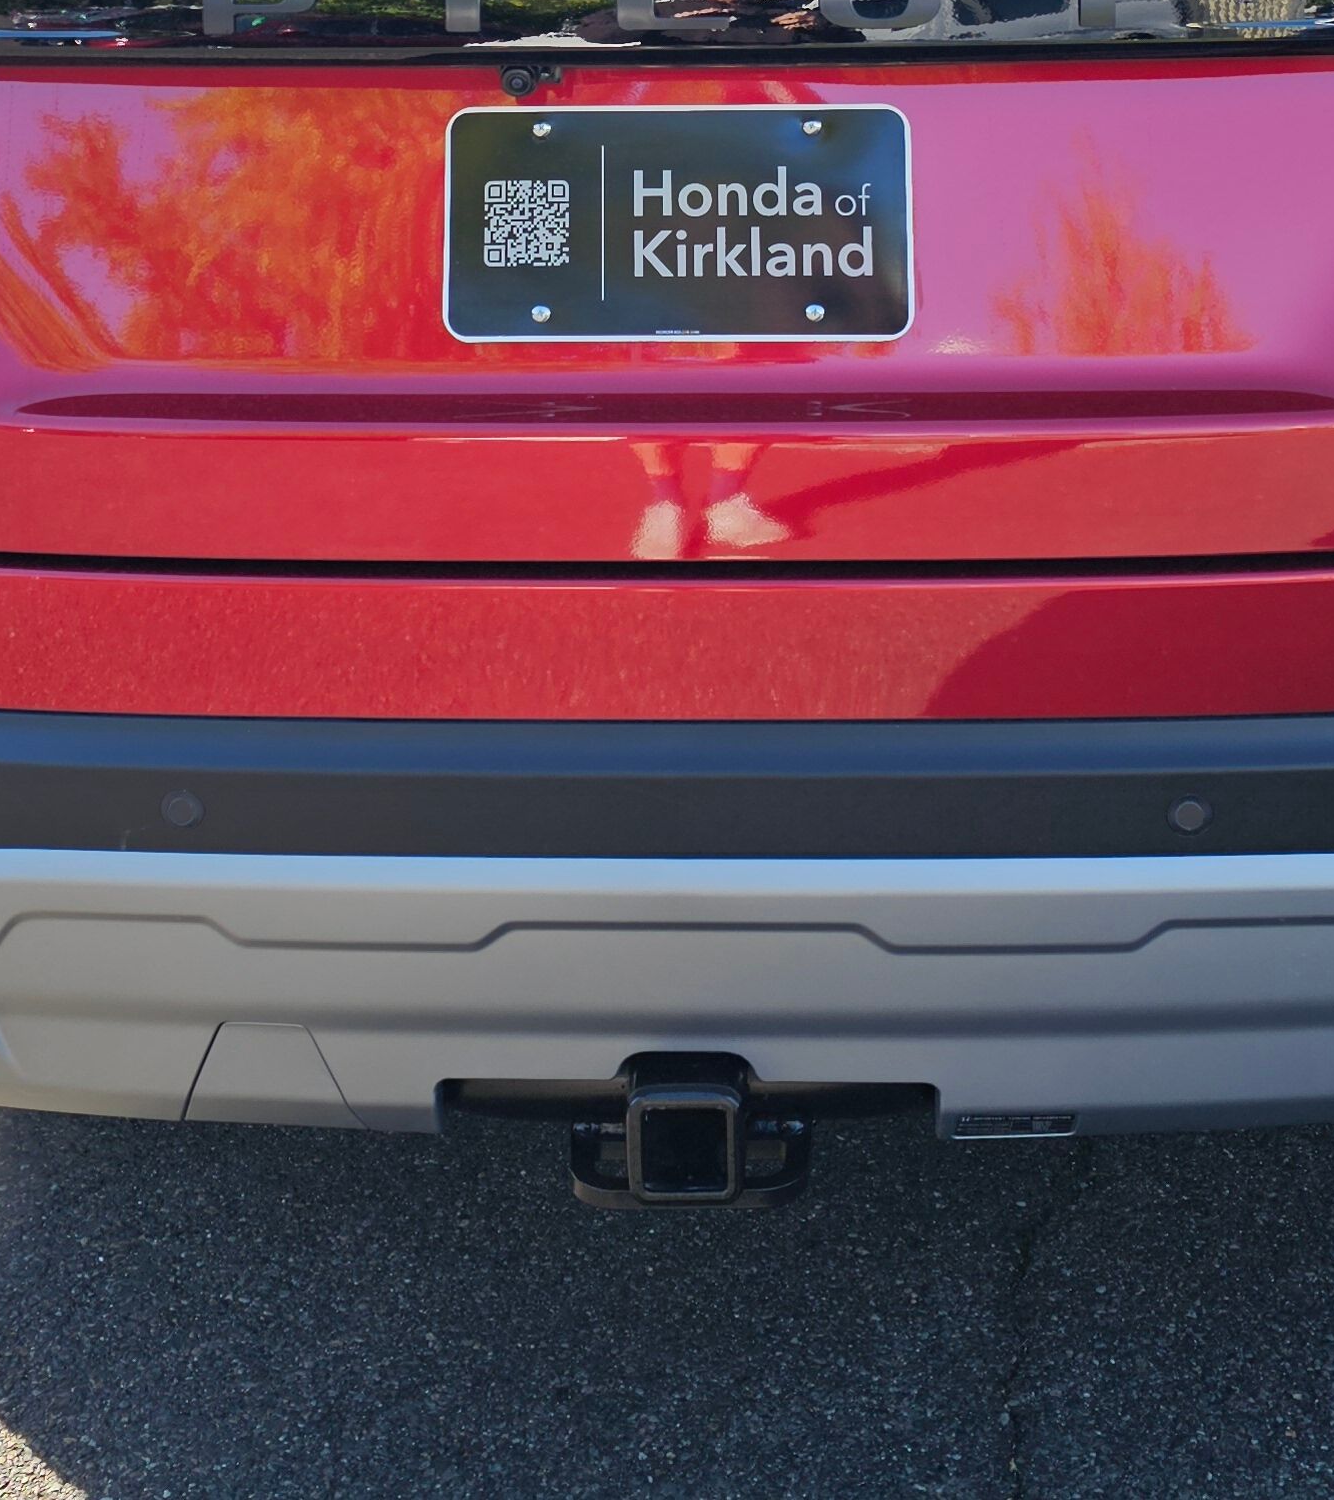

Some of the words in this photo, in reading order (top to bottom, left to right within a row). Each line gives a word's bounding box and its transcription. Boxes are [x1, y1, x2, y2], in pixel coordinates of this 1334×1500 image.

[633, 165, 823, 217] Honda
[834, 183, 871, 217] of
[633, 226, 874, 277] Kirkland
